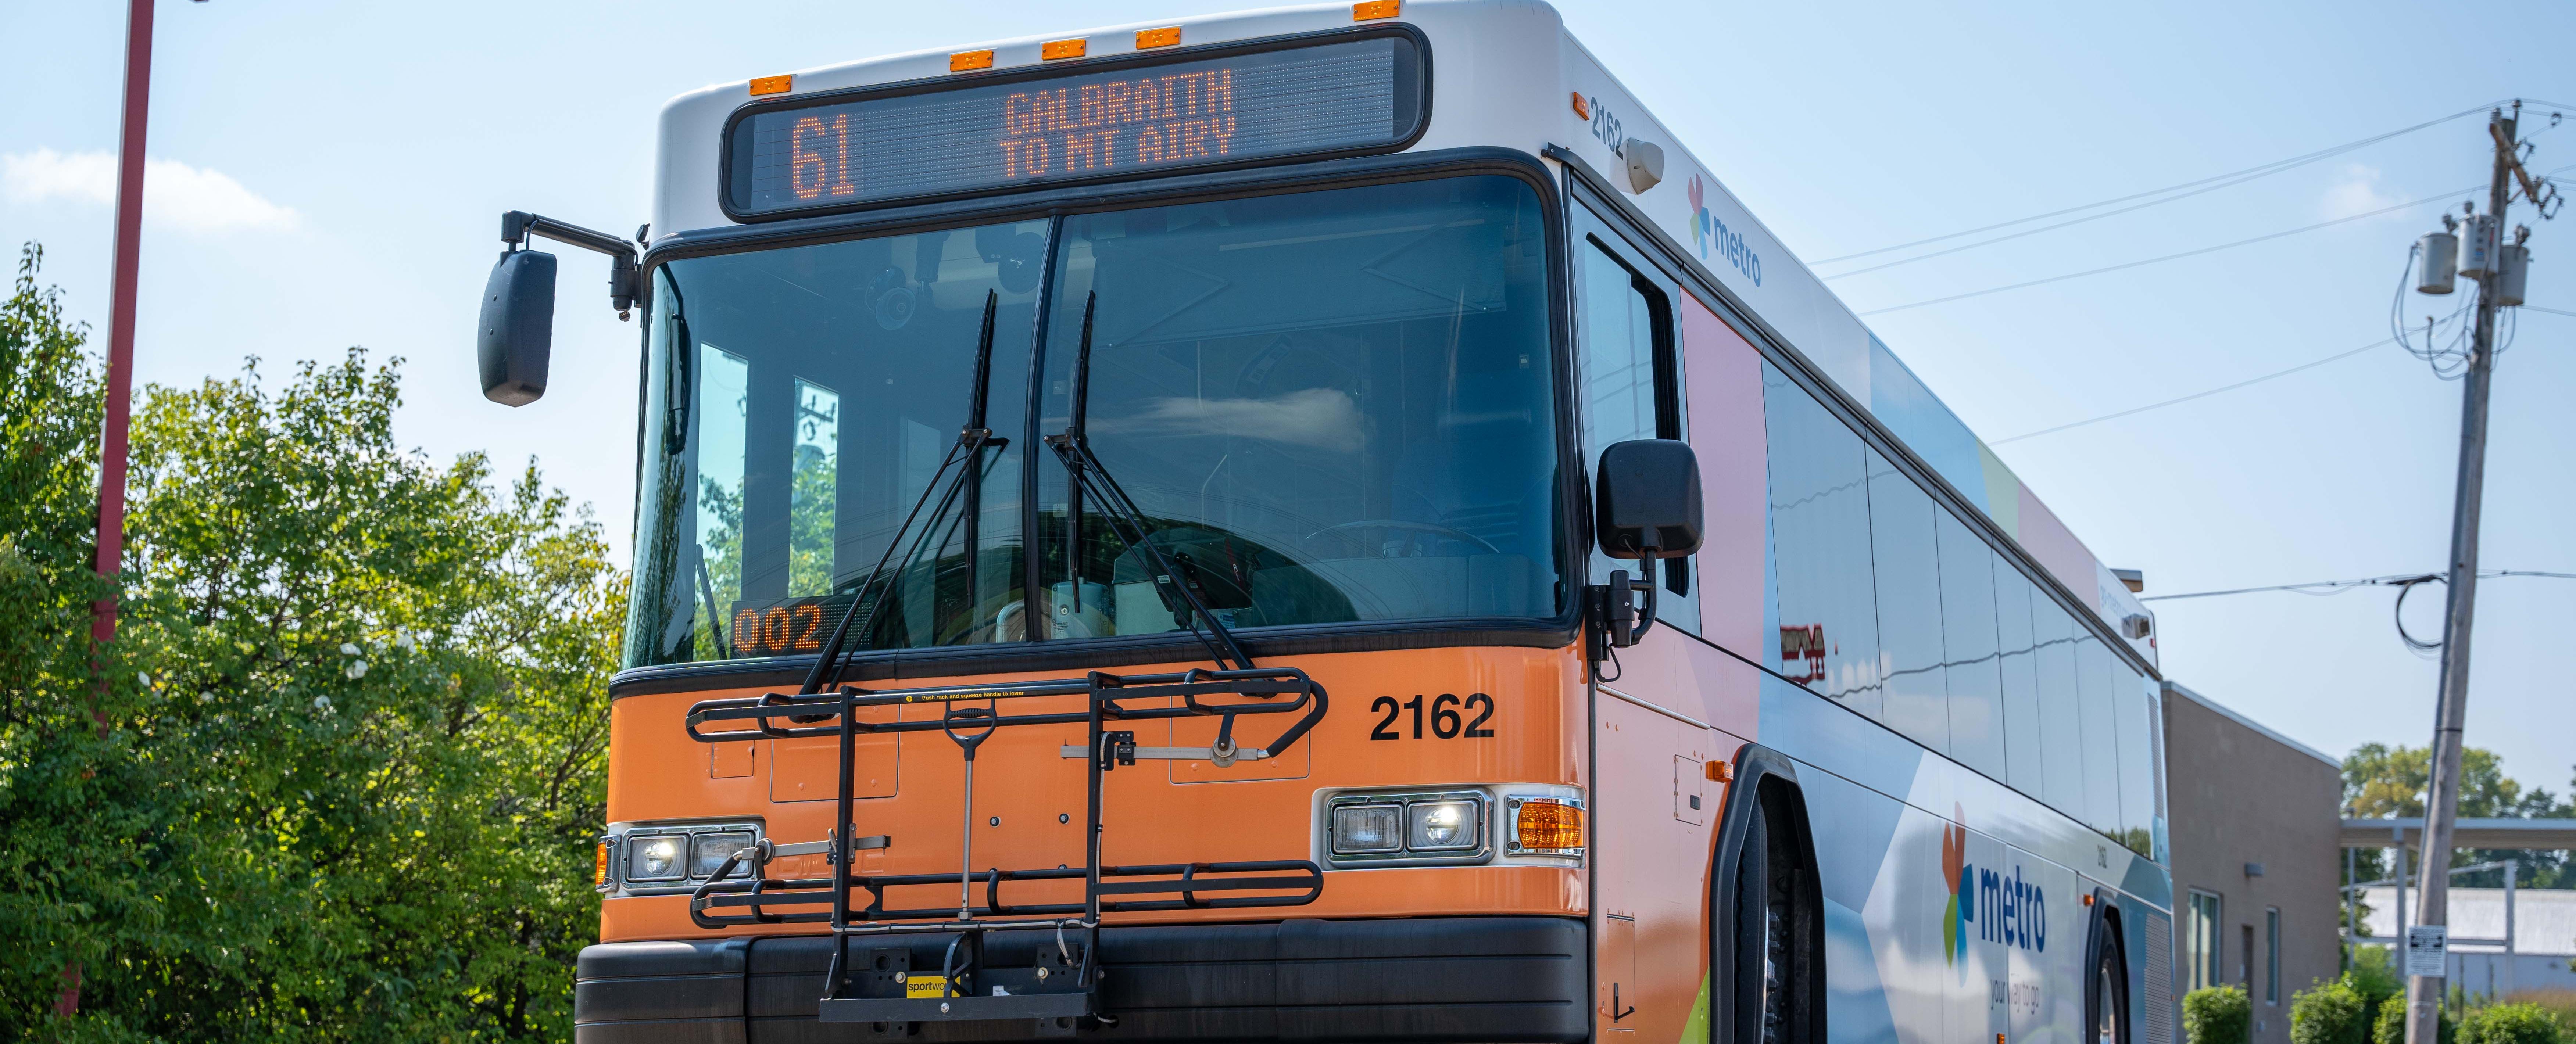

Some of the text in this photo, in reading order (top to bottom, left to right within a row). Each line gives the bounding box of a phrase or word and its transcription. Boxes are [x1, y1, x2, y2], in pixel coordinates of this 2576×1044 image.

[1007, 69, 1230, 134] GALBRAITH
[1591, 97, 1623, 160] 2162
[793, 114, 854, 198] 61
[1000, 116, 1235, 177] TO MT AIRY
[1714, 215, 1761, 287] metro
[735, 604, 820, 651] 002
[1370, 693, 1494, 741] 2162
[1981, 865, 2045, 953] metro
[908, 982, 947, 992] sportwo
[1990, 979, 2005, 1011] your
[2022, 981, 2029, 1007] to
[2031, 986, 2039, 1015] go
